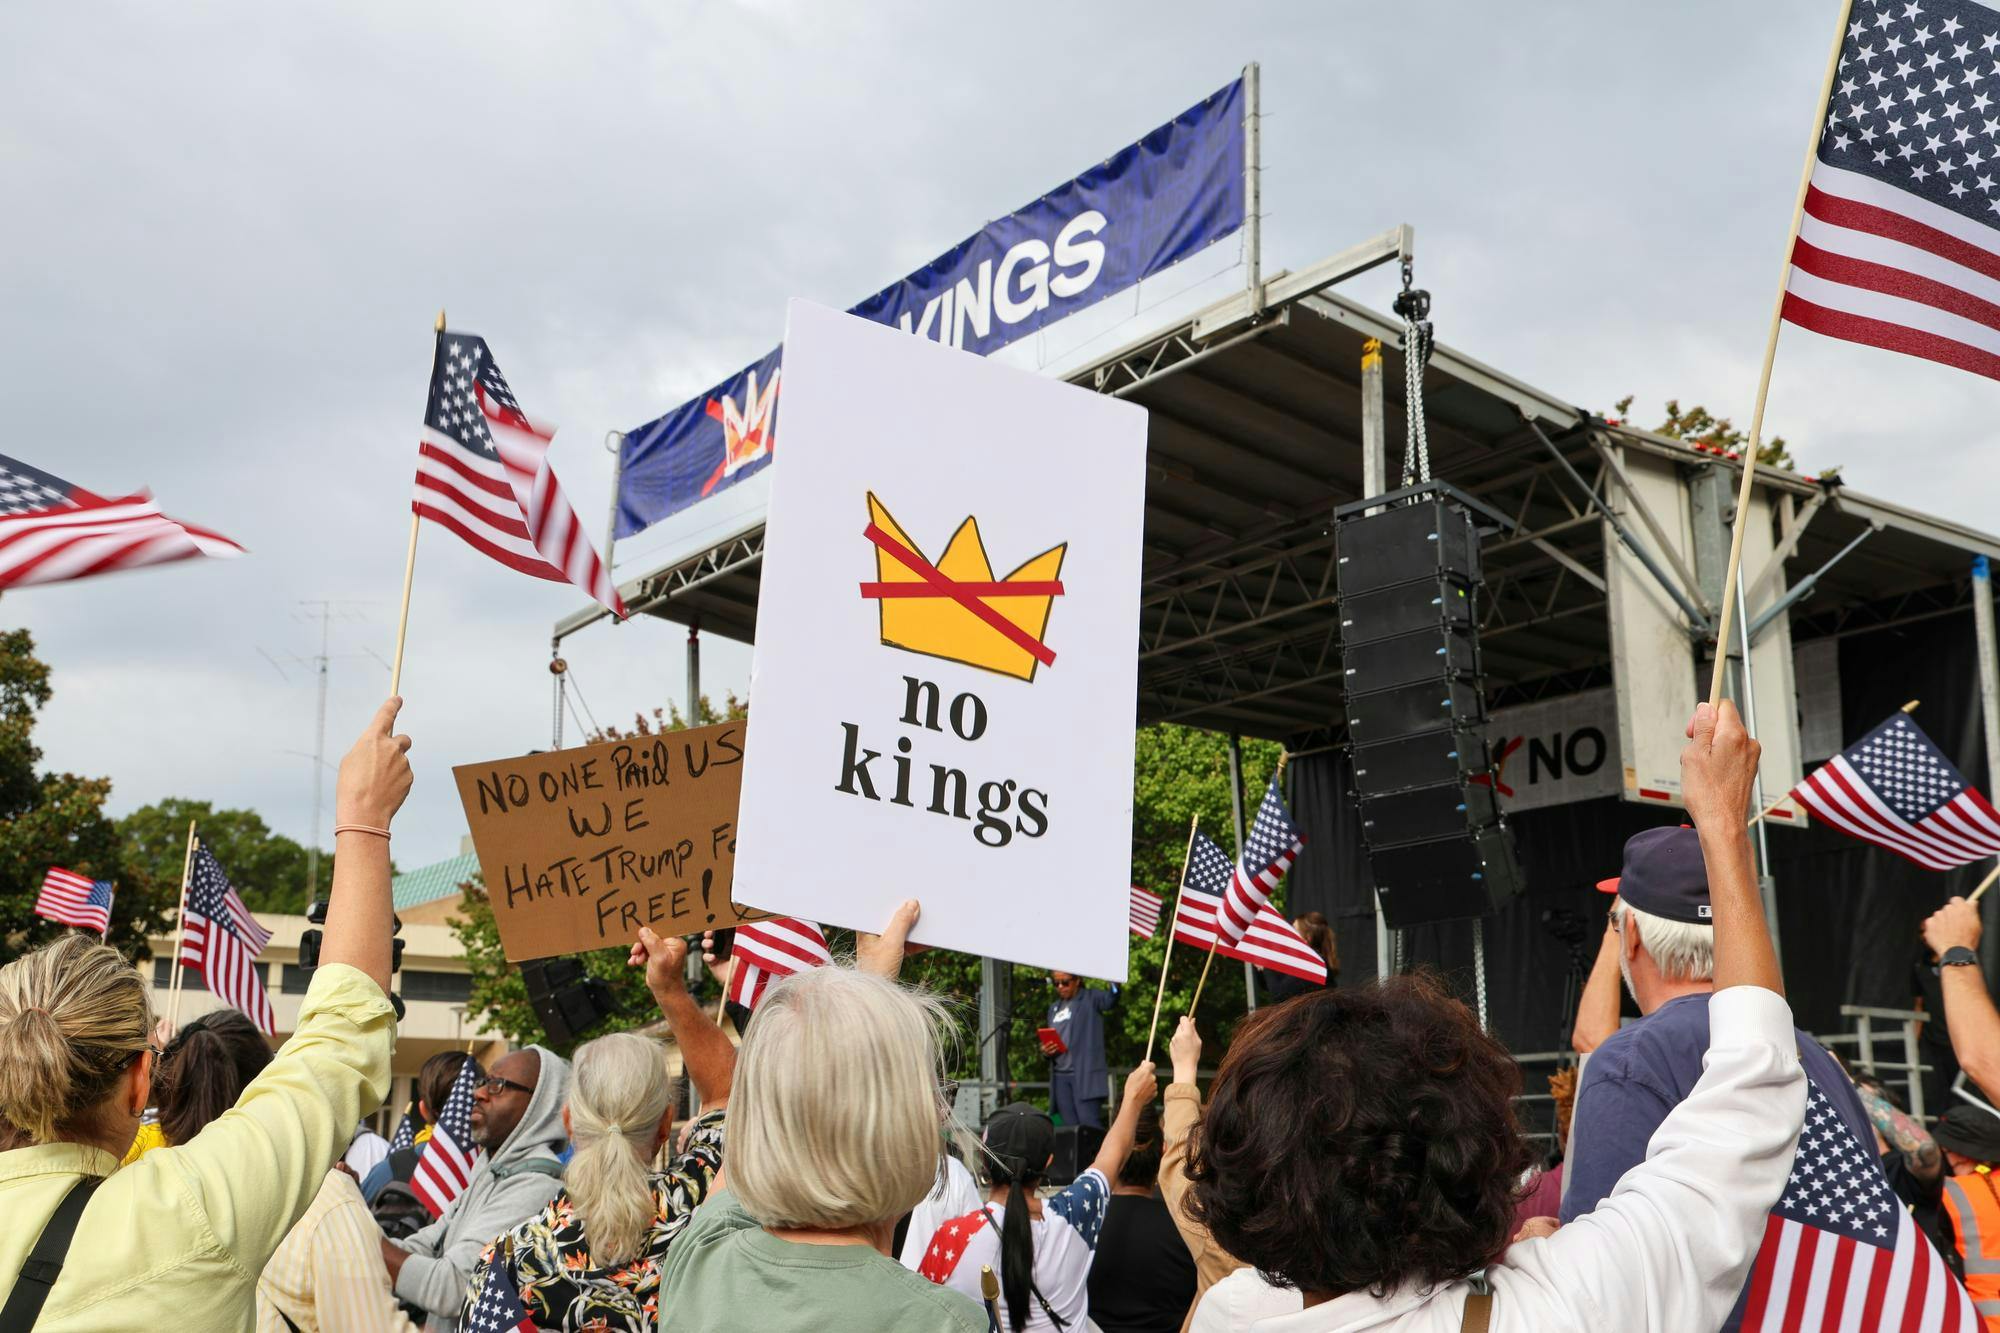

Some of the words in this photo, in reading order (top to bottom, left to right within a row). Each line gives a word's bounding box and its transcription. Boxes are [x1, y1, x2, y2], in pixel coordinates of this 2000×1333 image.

[899, 675, 988, 742] no
[477, 771, 529, 815] NO
[538, 758, 604, 802] ONE
[685, 729, 744, 778] US
[834, 721, 1049, 848] kings
[1528, 726, 1607, 785] NO
[568, 798, 649, 837] WE
[505, 857, 590, 909] HATE
[590, 839, 694, 884] TRUMP
